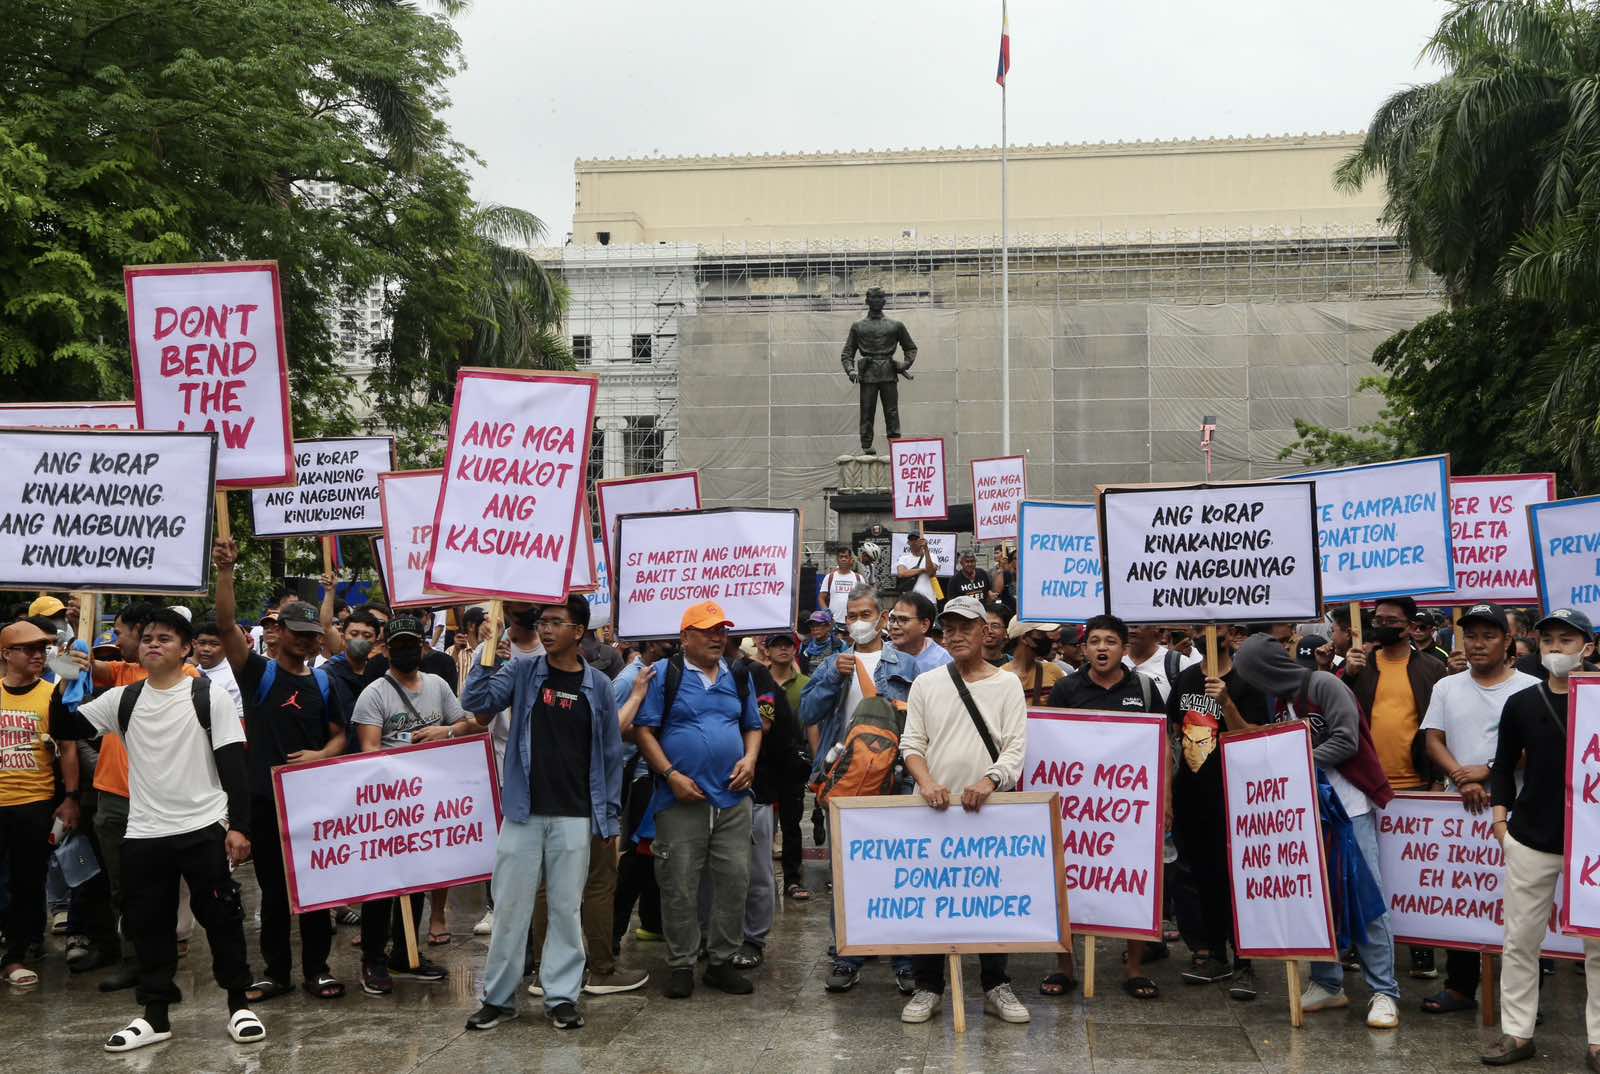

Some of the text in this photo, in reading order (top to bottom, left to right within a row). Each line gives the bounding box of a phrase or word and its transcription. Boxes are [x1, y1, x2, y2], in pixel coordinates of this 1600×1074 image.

[154, 304, 258, 340] DON'T
[161, 342, 256, 377] BEND
[179, 380, 246, 415] THE
[462, 421, 574, 453] ANG MGA
[34, 452, 81, 475] ANG
[295, 453, 310, 467] NG
[457, 455, 573, 488] KURAKOT
[902, 466, 935, 479] BEND
[978, 475, 1020, 486] ANG MGA
[266, 486, 379, 506] ANG NAGBUNYAG
[908, 481, 931, 493] THE
[978, 488, 1021, 501] KURAKOT
[483, 494, 536, 521] ANG
[906, 495, 933, 507] LAW
[991, 502, 1010, 512] ANG
[1342, 493, 1436, 520] CAMPAIGN
[0, 513, 185, 538] ANG NAGBUNYAG
[980, 514, 1018, 525] KASUHA
[1152, 506, 1193, 527] ANG
[1318, 523, 1396, 547] ONATION
[1451, 521, 1507, 540] OLETA
[446, 525, 563, 561] KASUHAN
[1031, 534, 1095, 552] PRIVATE
[627, 546, 786, 566] SI MARTIN ANG UMAMIN
[1338, 545, 1424, 571] PLUNDER
[636, 563, 776, 584] BAKIT SI MARCOLETA
[1127, 561, 1167, 582] ANG
[1176, 556, 1295, 580] NAGBUNYAG
[629, 581, 784, 602] ANG GUSTONG LITISIN?
[1042, 581, 1087, 597] HINDI
[1031, 760, 1147, 790] ANG MGA
[357, 777, 423, 807] HUWAG
[1247, 777, 1288, 804] DAPAT
[313, 796, 473, 842] IPAKULONG ANG
[1061, 796, 1149, 824] RAKOT
[1236, 808, 1305, 837] MANAGOT
[1442, 819, 1464, 837] SI
[850, 835, 1045, 860] PRIVATE CAMPAIGN
[1064, 830, 1114, 857] ANG
[1242, 841, 1308, 868] ANG MGA
[1401, 842, 1439, 861] ANG
[895, 867, 999, 889] DONATION
[1065, 864, 1147, 897] SUHAN
[1420, 869, 1444, 887] EH
[868, 895, 1031, 919] HINDI PLUNDER
